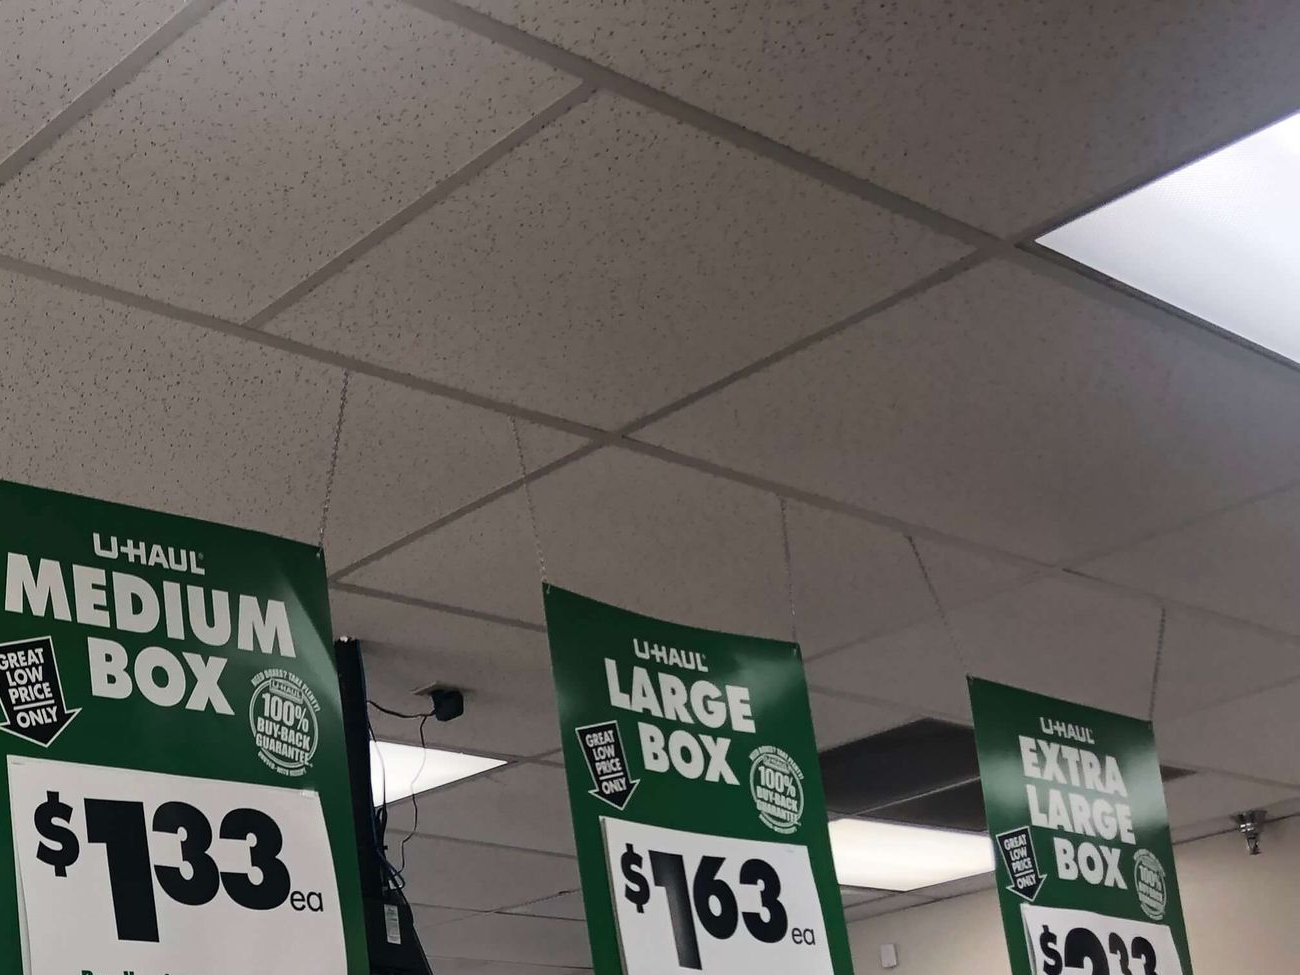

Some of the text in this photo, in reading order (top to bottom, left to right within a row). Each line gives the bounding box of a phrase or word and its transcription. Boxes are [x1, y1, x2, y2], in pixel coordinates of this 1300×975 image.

[5, 552, 296, 657] MEDIUM
[7, 666, 43, 687] LOW
[88, 637, 235, 715] BOX
[9, 682, 52, 704] PRICE
[604, 658, 756, 733] LARGE
[16, 706, 58, 729] ONLY
[262, 693, 308, 732] 100%
[257, 717, 309, 750] BUY-BACK
[586, 730, 615, 747] GREAT
[256, 735, 311, 764] GUARANTEE
[593, 744, 615, 760] LOW
[638, 722, 740, 785] BOX
[595, 758, 622, 775] PRICE
[1019, 735, 1128, 797] EXTRA
[602, 778, 627, 795] ONLY
[1026, 784, 1136, 845] LARGE
[1053, 837, 1128, 890] BOX
[291, 891, 323, 911] ea
[792, 927, 815, 945] ea
